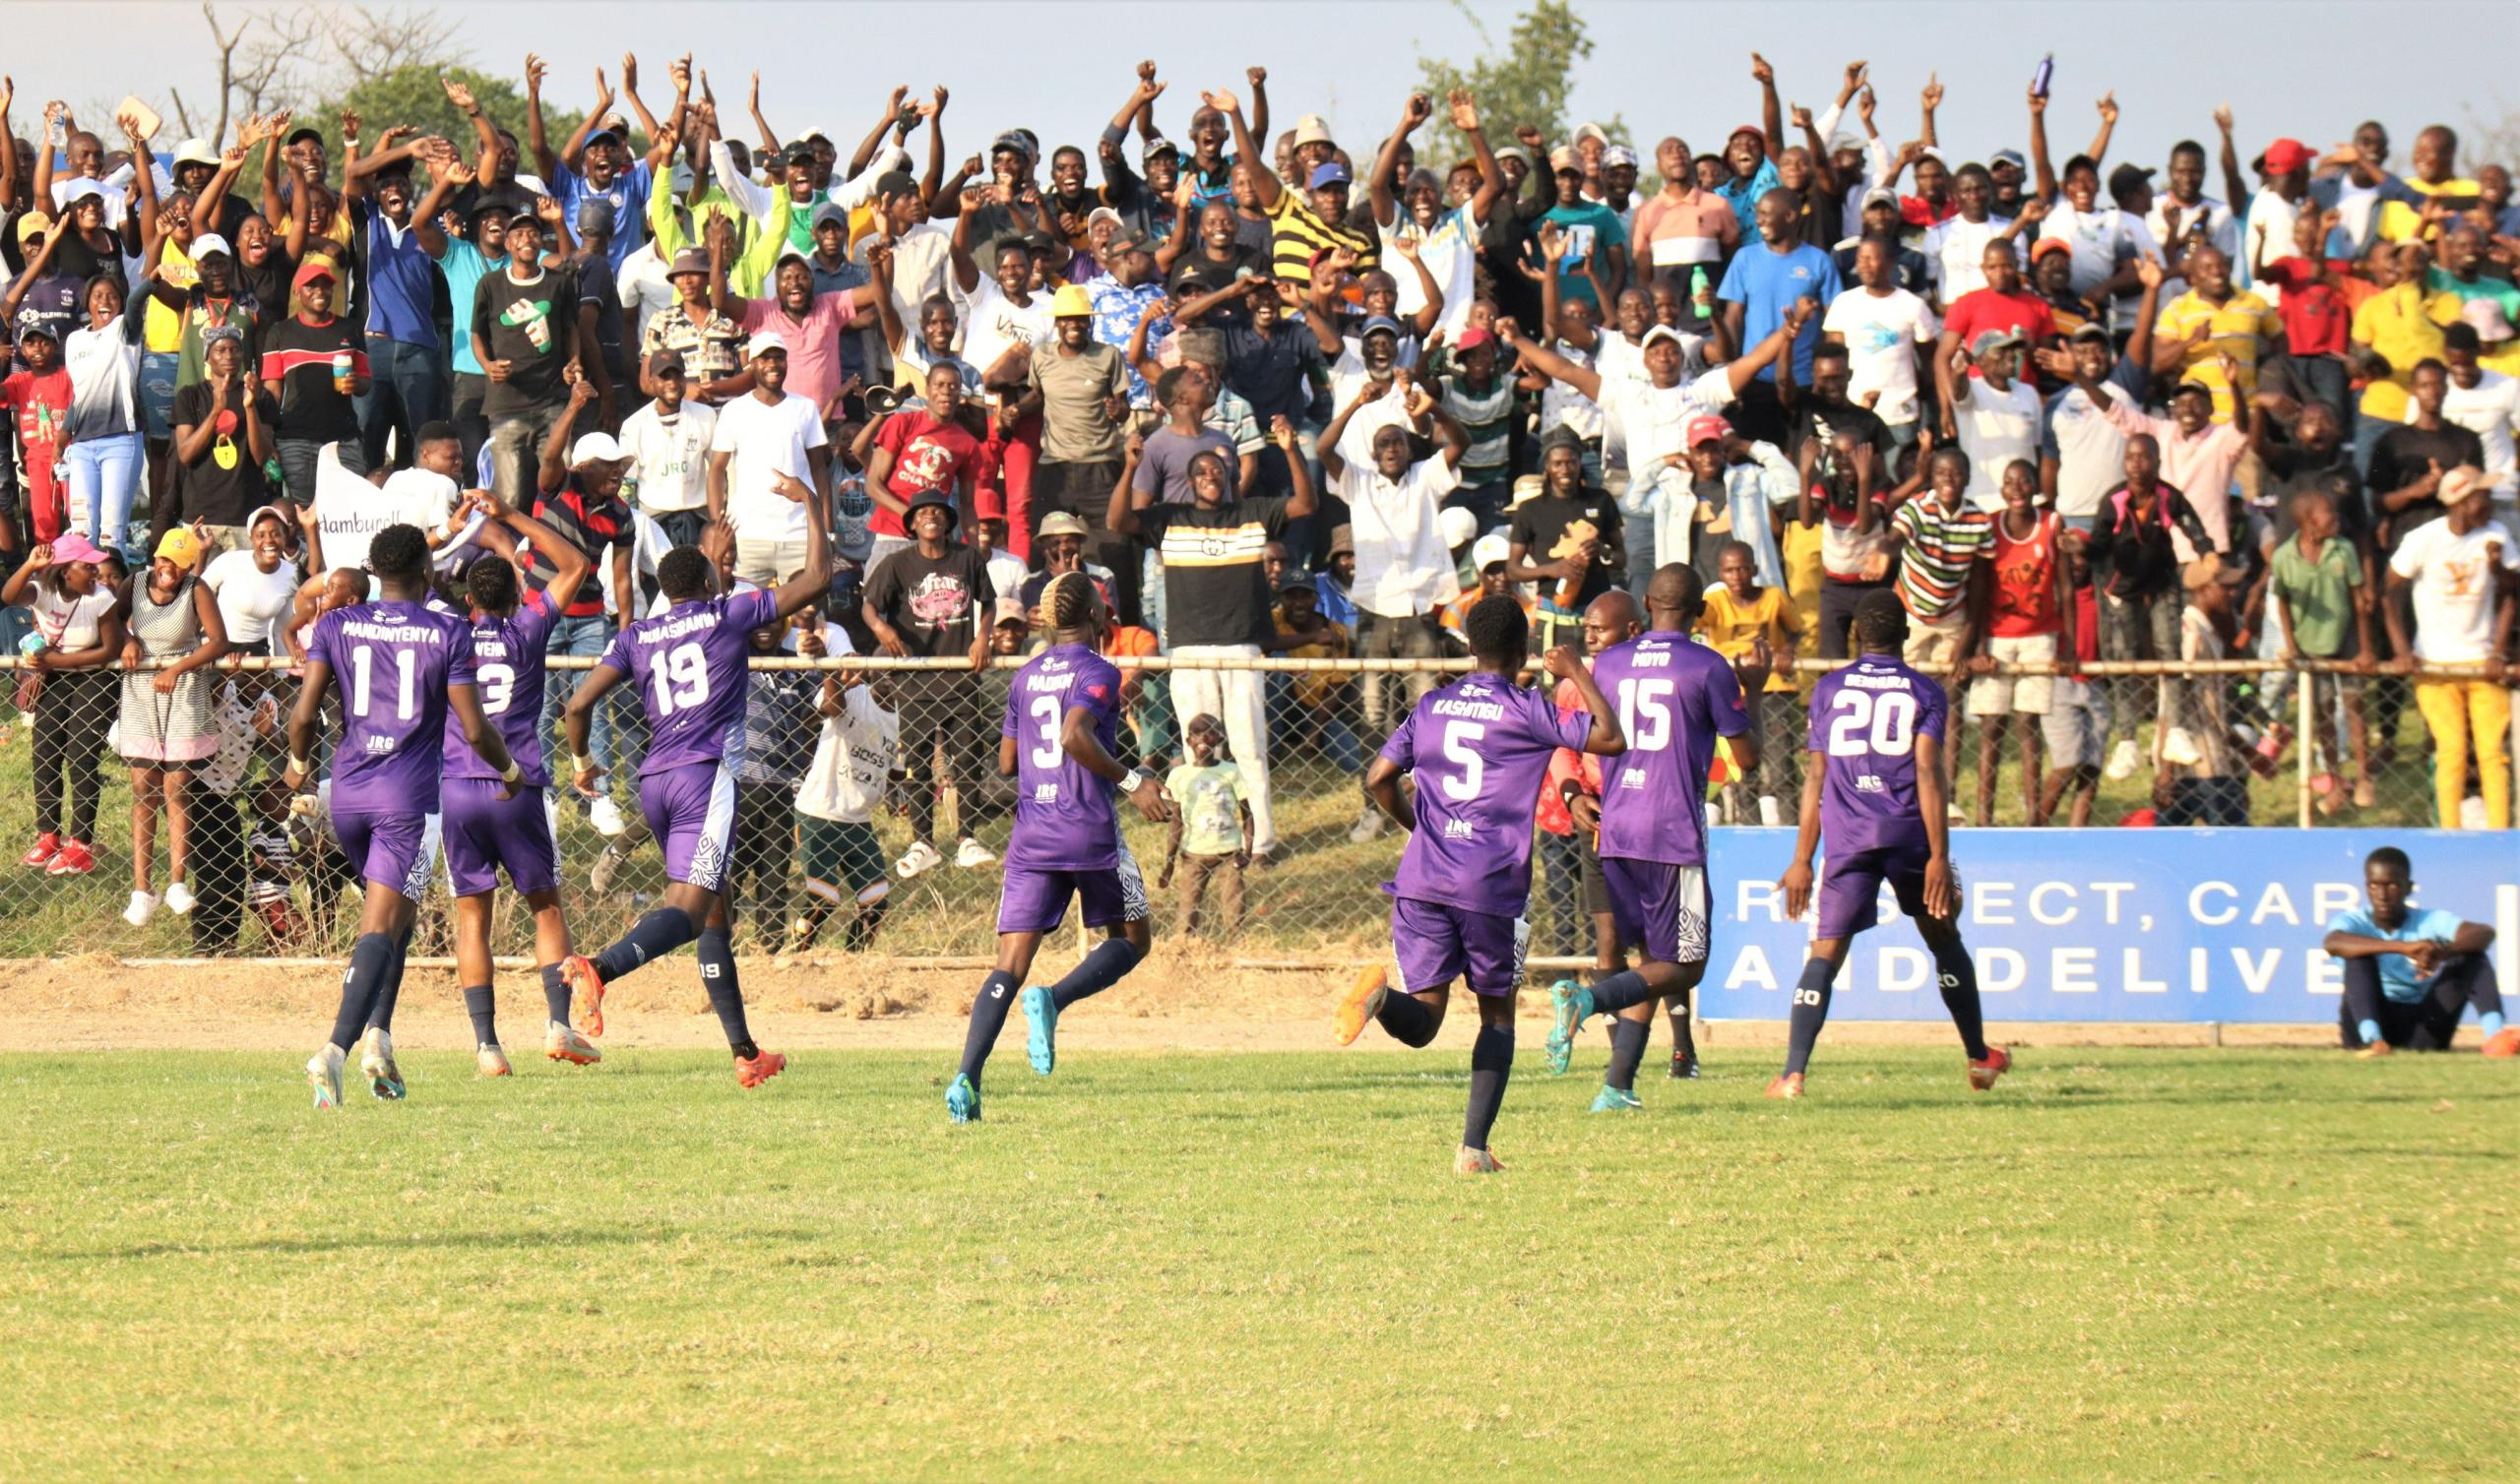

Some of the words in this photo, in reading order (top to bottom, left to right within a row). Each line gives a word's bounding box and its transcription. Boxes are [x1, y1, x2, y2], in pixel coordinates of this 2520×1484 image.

[661, 461, 689, 477] JRG
[342, 621, 440, 645] MANDINYENYA
[352, 645, 415, 720] 11
[650, 642, 710, 716] 19
[1431, 700, 1504, 721] KASHITIGU
[1618, 678, 1673, 751] 15
[1030, 695, 1063, 769] 3
[1829, 689, 1917, 756] 20
[366, 735, 394, 750] JRG
[1442, 719, 1484, 800] 5
[1622, 768, 1647, 783] JRG
[1856, 775, 1883, 789] JRG
[1035, 783, 1058, 798] JRG
[700, 963, 721, 979] 19
[1975, 946, 2347, 994] DELIVE
[990, 983, 1004, 999] 3
[1794, 987, 1821, 1006] 20
